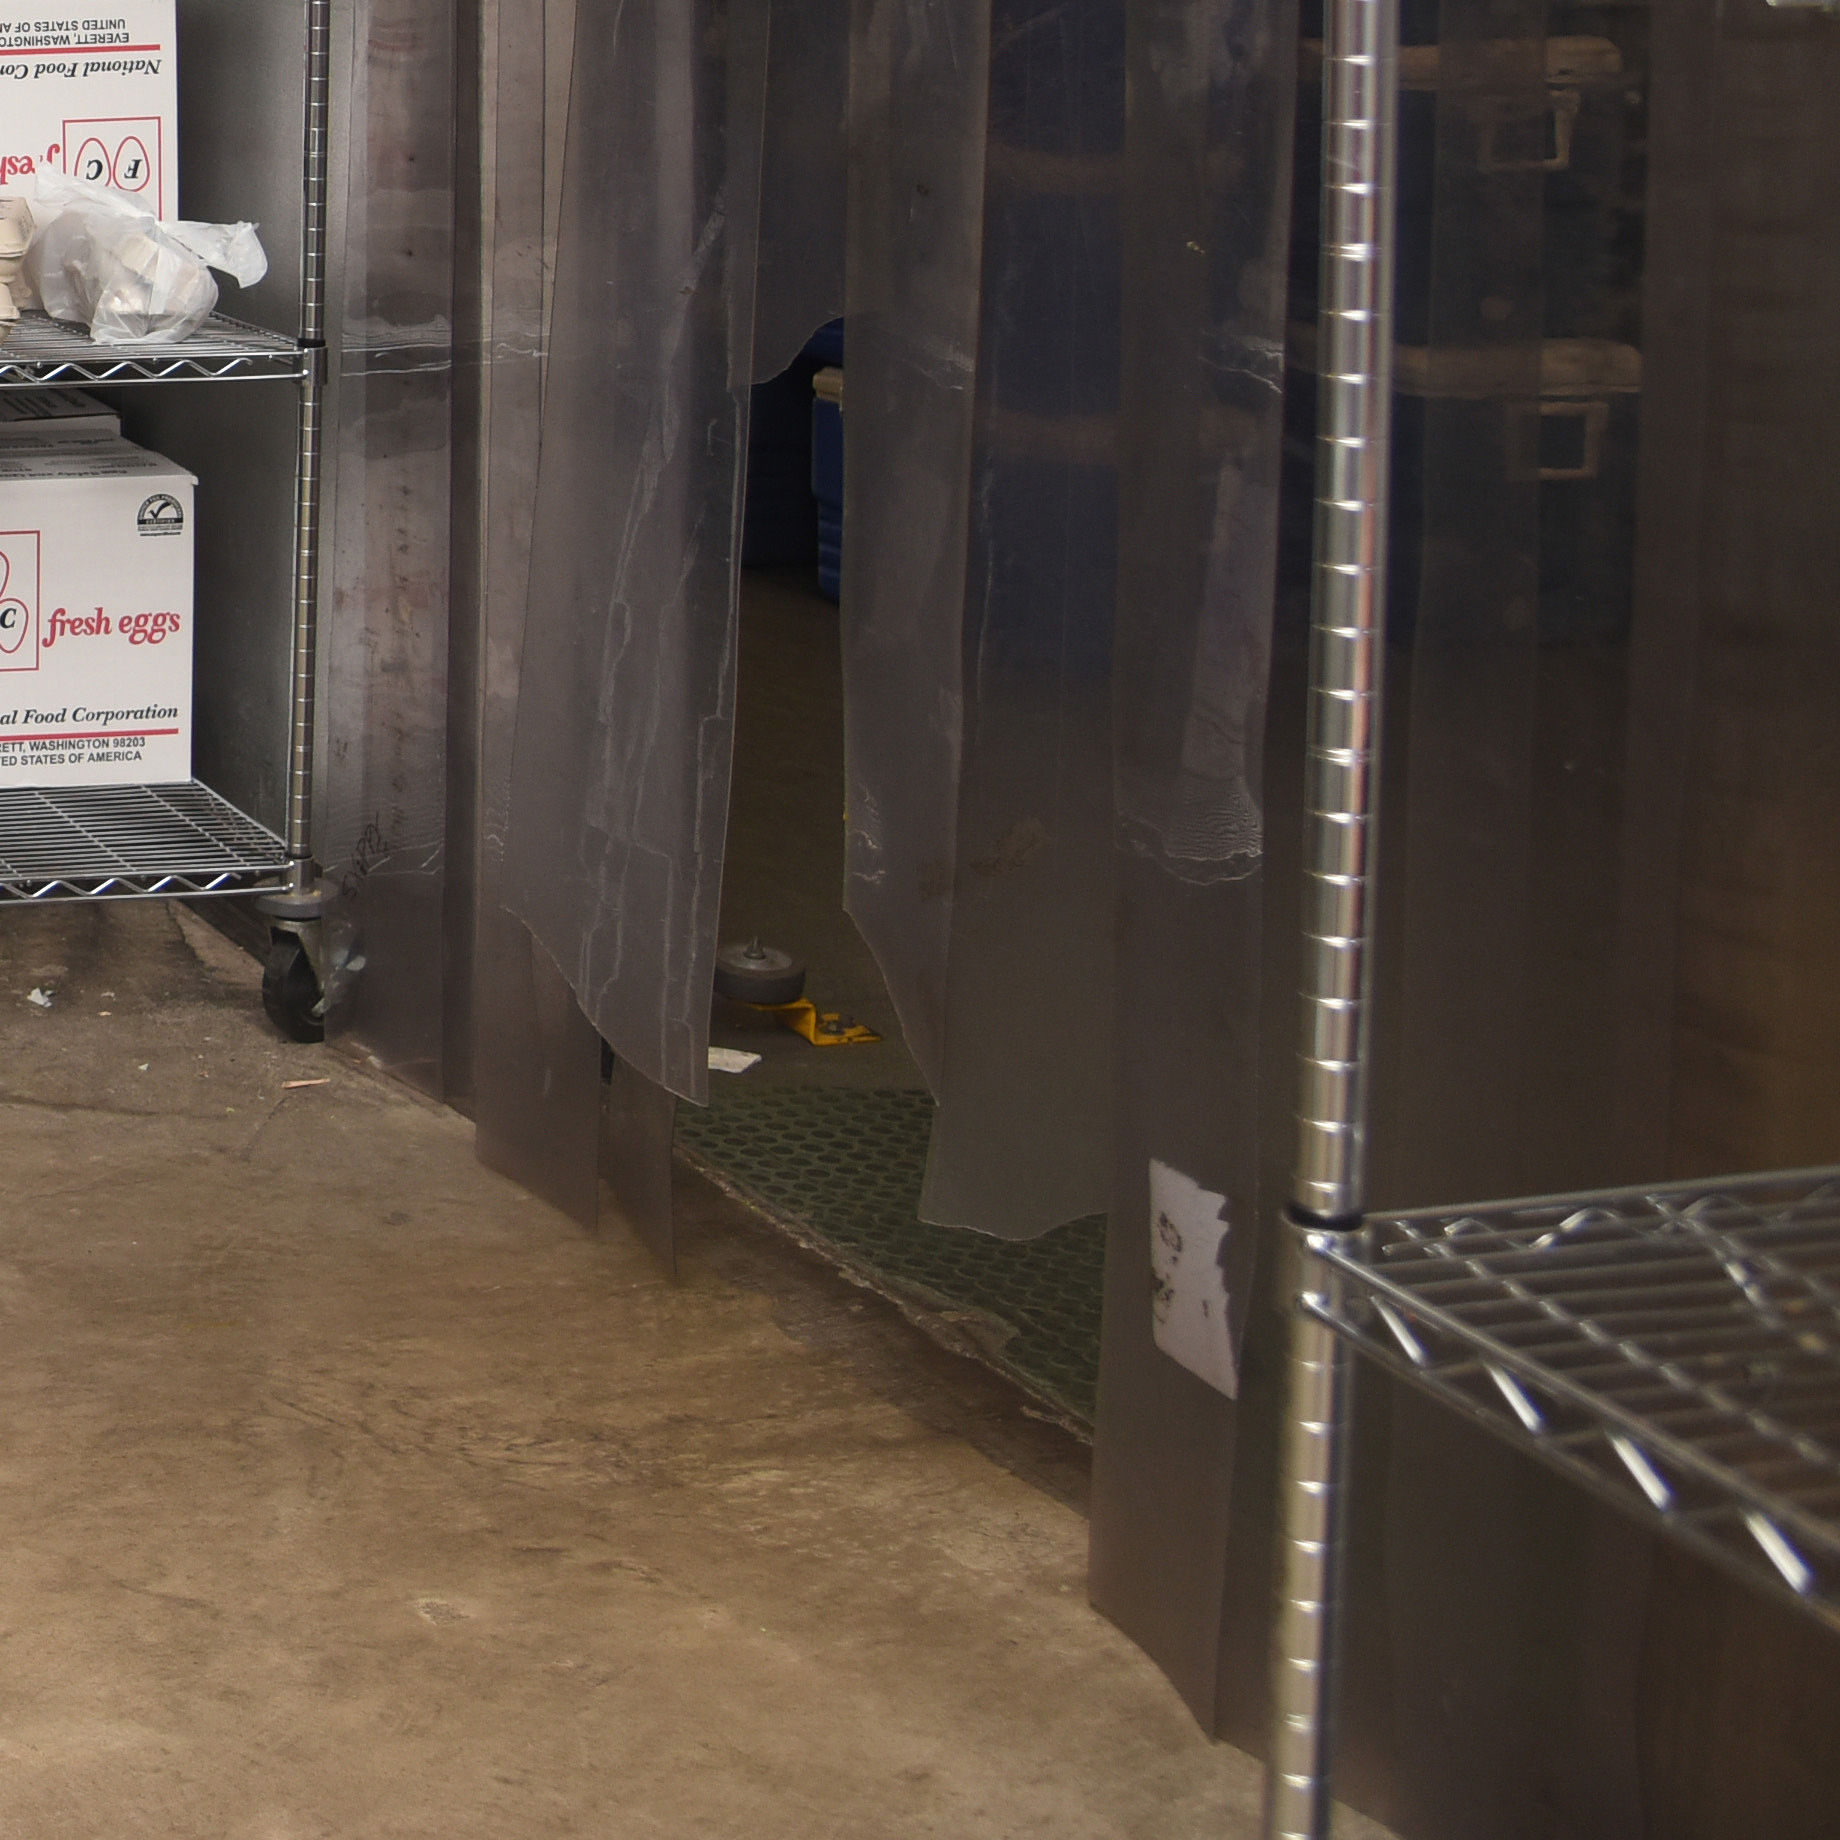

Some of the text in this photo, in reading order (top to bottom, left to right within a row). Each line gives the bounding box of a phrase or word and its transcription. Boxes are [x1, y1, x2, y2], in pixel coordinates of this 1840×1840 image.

[15, 21, 32, 32] OF
[34, 20, 78, 32] STATES
[81, 19, 126, 31] UNITED
[72, 32, 130, 45] EVERETT,
[34, 61, 78, 78] Food
[82, 59, 162, 76] National
[85, 159, 142, 180] F C
[0, 608, 17, 629] C
[41, 607, 181, 648] fresh eggs
[22, 708, 66, 724] Food
[72, 703, 178, 726] Corporation
[29, 738, 110, 752] WASHINGTON
[113, 736, 146, 748] 98203
[20, 753, 65, 765] STATES
[69, 752, 84, 763] OF
[87, 750, 142, 762] AMERICA
